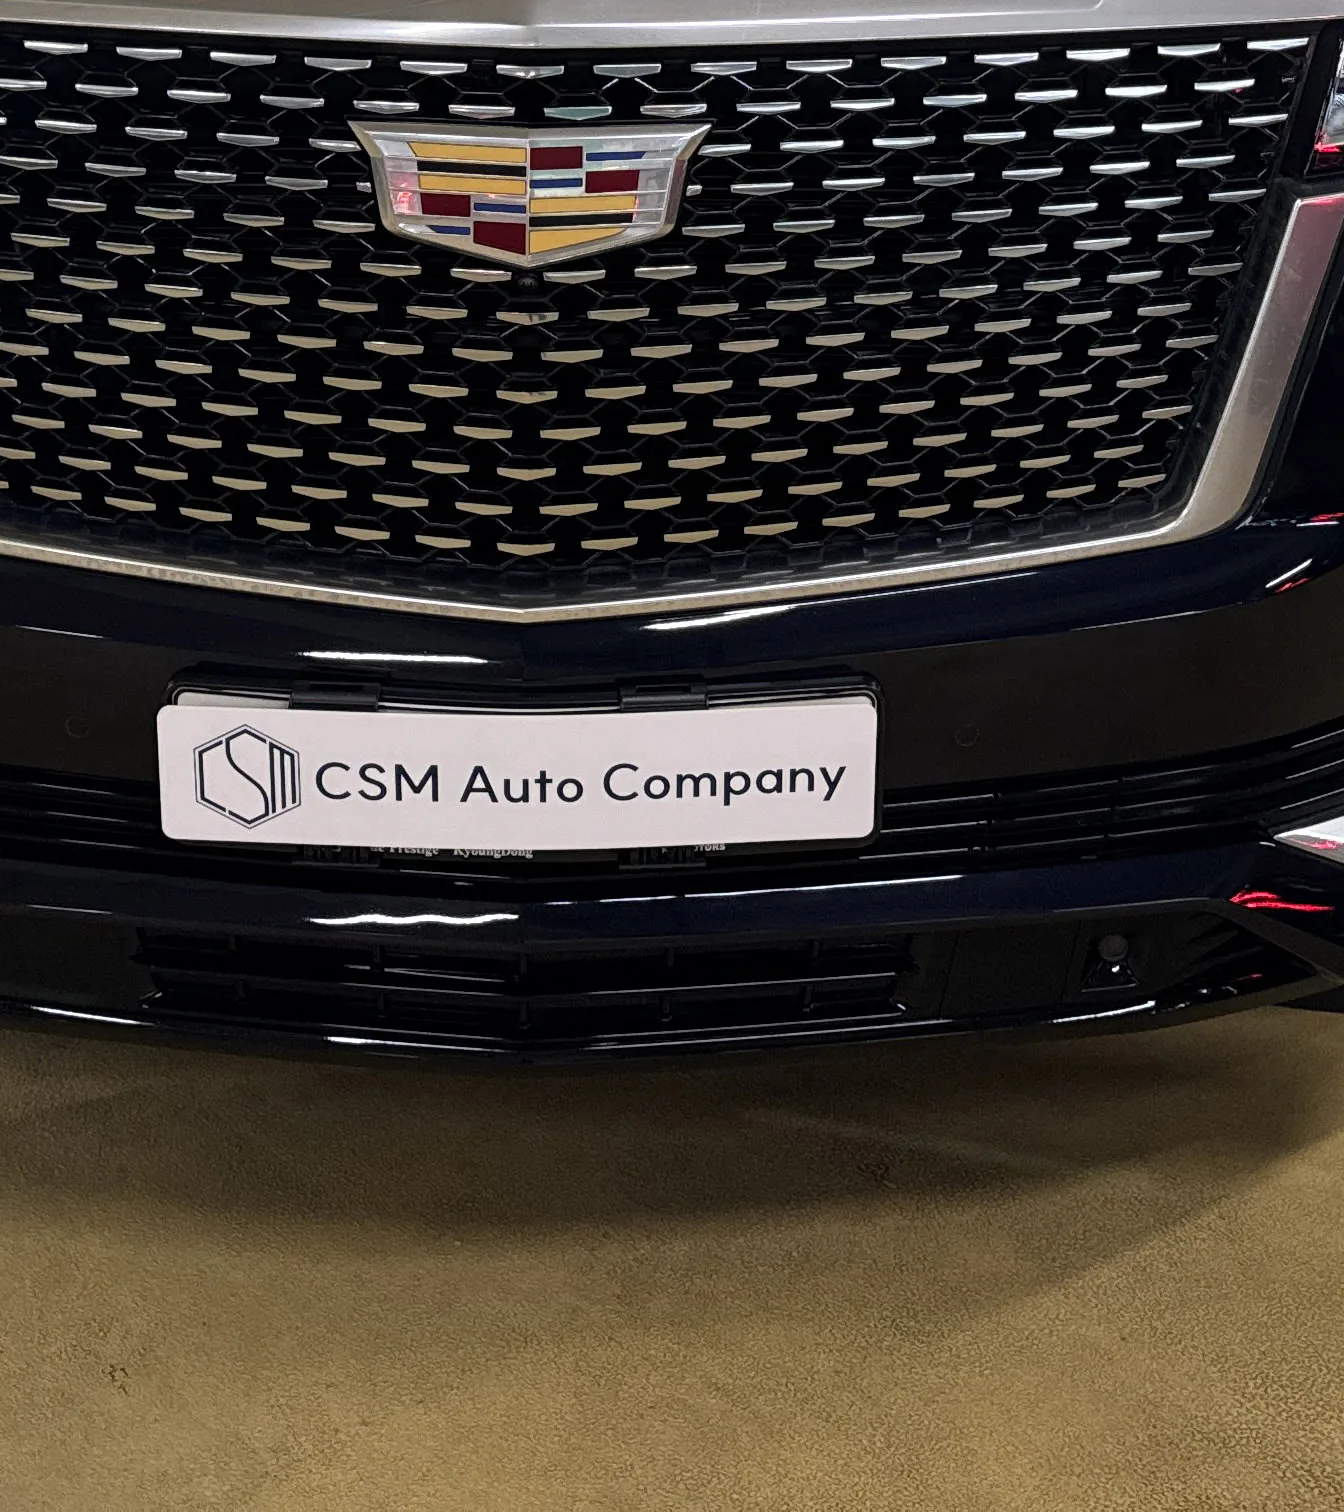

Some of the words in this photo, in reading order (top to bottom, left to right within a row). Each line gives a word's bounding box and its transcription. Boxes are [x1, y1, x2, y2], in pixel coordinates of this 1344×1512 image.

[315, 761, 439, 803] CSM
[459, 764, 584, 804] Auto
[602, 762, 847, 807] Company
